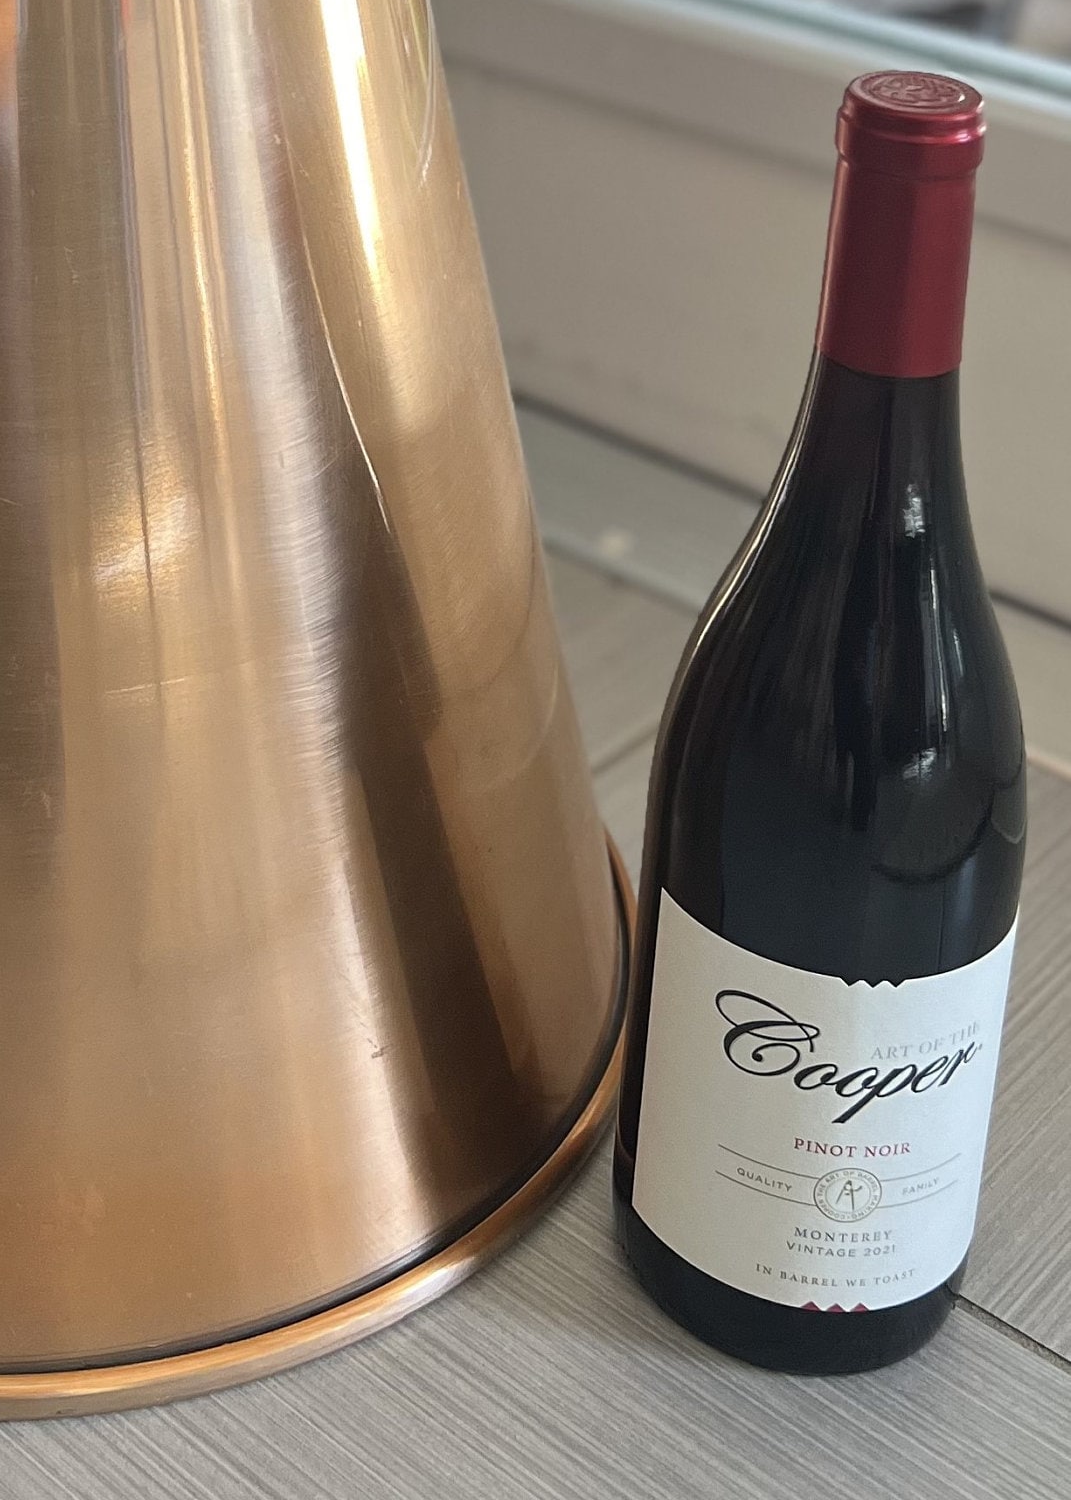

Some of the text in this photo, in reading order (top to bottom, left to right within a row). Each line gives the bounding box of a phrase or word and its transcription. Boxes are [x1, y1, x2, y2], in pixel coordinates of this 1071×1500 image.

[715, 989, 976, 1123] Cooper
[871, 1045, 912, 1060] ART
[919, 1038, 943, 1053] OF
[794, 1137, 911, 1158] PINOT NOIR
[736, 1167, 940, 1196] QUALITY FAMILY
[794, 1226, 893, 1243] MONTEREY
[786, 1240, 896, 1257] VINTAGE 2021
[756, 1263, 916, 1287] IN BARREL WE TOAST
